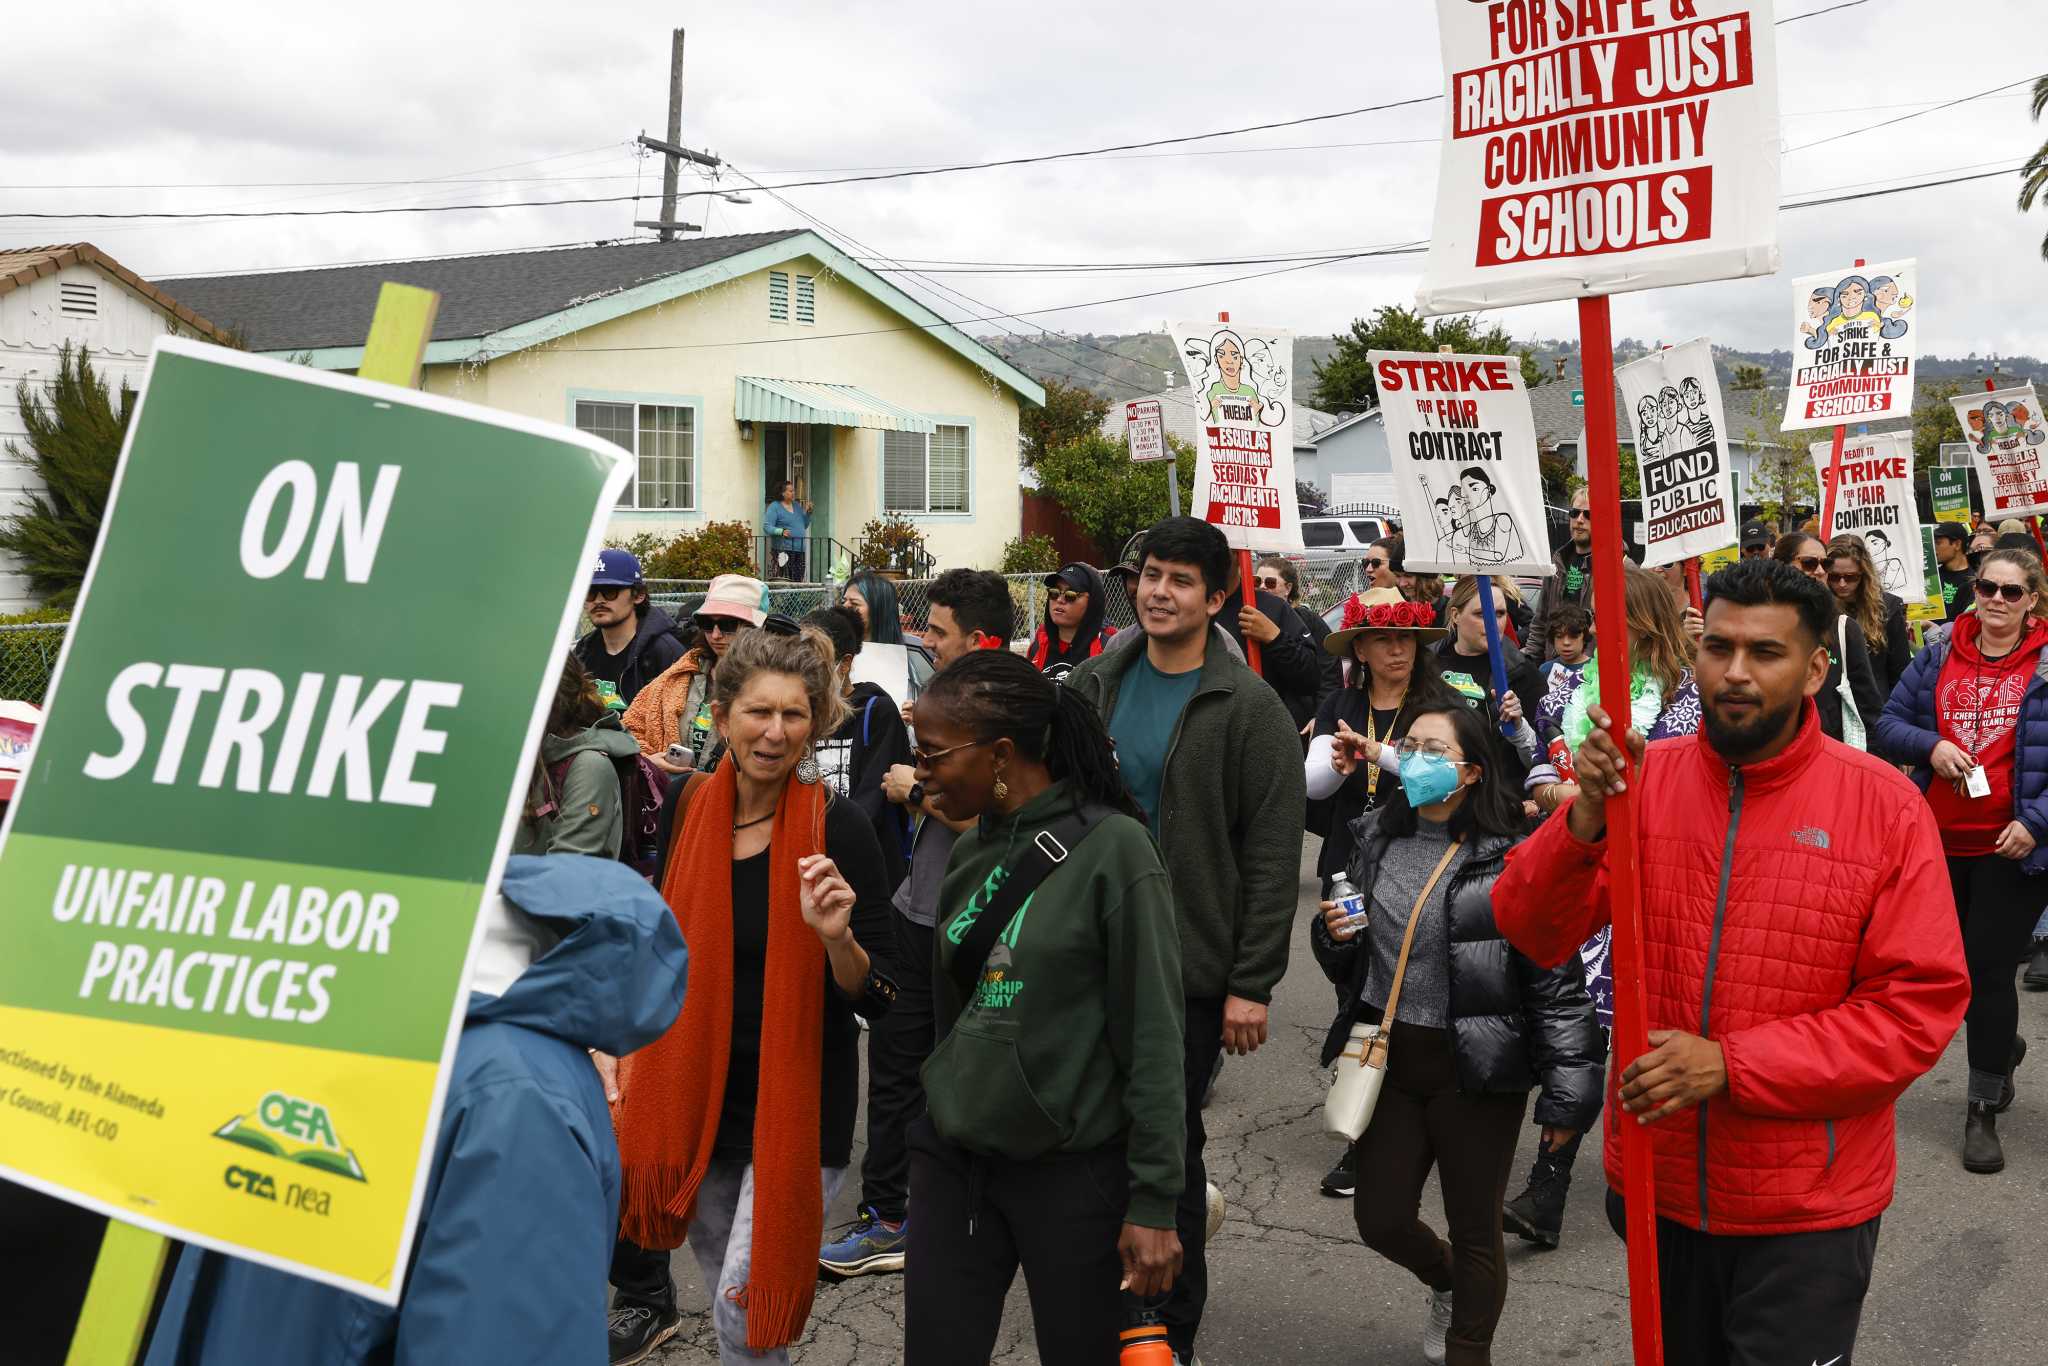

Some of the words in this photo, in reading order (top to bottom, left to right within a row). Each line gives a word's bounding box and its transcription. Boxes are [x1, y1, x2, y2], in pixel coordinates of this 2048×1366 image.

[1488, 0, 1548, 60] FOR
[1459, 42, 1618, 132] RACIALLY
[1635, 19, 1742, 98] JUST
[1484, 98, 1710, 190] COMMUNITY
[1495, 174, 1689, 261] SCHOOLS
[1838, 326, 1869, 343] STRIKE
[1815, 346, 1840, 365] FOR
[1843, 342, 1877, 358] SAFE
[1882, 343, 1891, 357] &
[1378, 359, 1513, 392] STRIKE
[1800, 358, 1865, 385] RACIALLY
[1868, 357, 1907, 375] JUST
[1809, 377, 1892, 399] COMMUNITY
[1127, 406, 1137, 418] NO
[1137, 405, 1159, 415] PARKING
[1222, 404, 1253, 421] HUELGA
[1416, 399, 1432, 413] FOR
[1437, 399, 1479, 429] FAIR
[1812, 394, 1884, 418] SCHOOLS
[1219, 428, 1269, 451] ESCUELAS
[1408, 431, 1503, 461] CONTRACT
[1844, 448, 1865, 460] READY
[1866, 447, 1874, 456] TO
[1260, 468, 1268, 486] Y
[1649, 451, 1713, 493] FUND
[1940, 471, 1952, 482] ON
[1650, 479, 1717, 518] PUBLIC
[1844, 489, 1855, 499] FOR
[1857, 485, 1885, 506] FAIR
[1935, 484, 1963, 497] STRIKE
[240, 460, 401, 584] ON
[1222, 505, 1259, 527] JUSTAS
[1649, 505, 1721, 541] EDUCATION
[1835, 504, 1899, 530] CONTRACT
[1962, 721, 1972, 729] OF
[1993, 708, 2006, 717] THE
[82, 661, 463, 808] STRIKE
[52, 864, 224, 939] UNFAIR
[230, 880, 400, 954] LABOR
[80, 941, 336, 1025] PRACTICES
[59, 1065, 76, 1090] by
[79, 1073, 102, 1095] the
[104, 1081, 165, 1119] Alameda
[9, 1087, 62, 1124] Council,
[65, 1107, 118, 1141] AFL-CIO
[260, 1093, 337, 1148] OEA
[224, 1164, 277, 1201] CTA
[285, 1183, 331, 1217] nea
